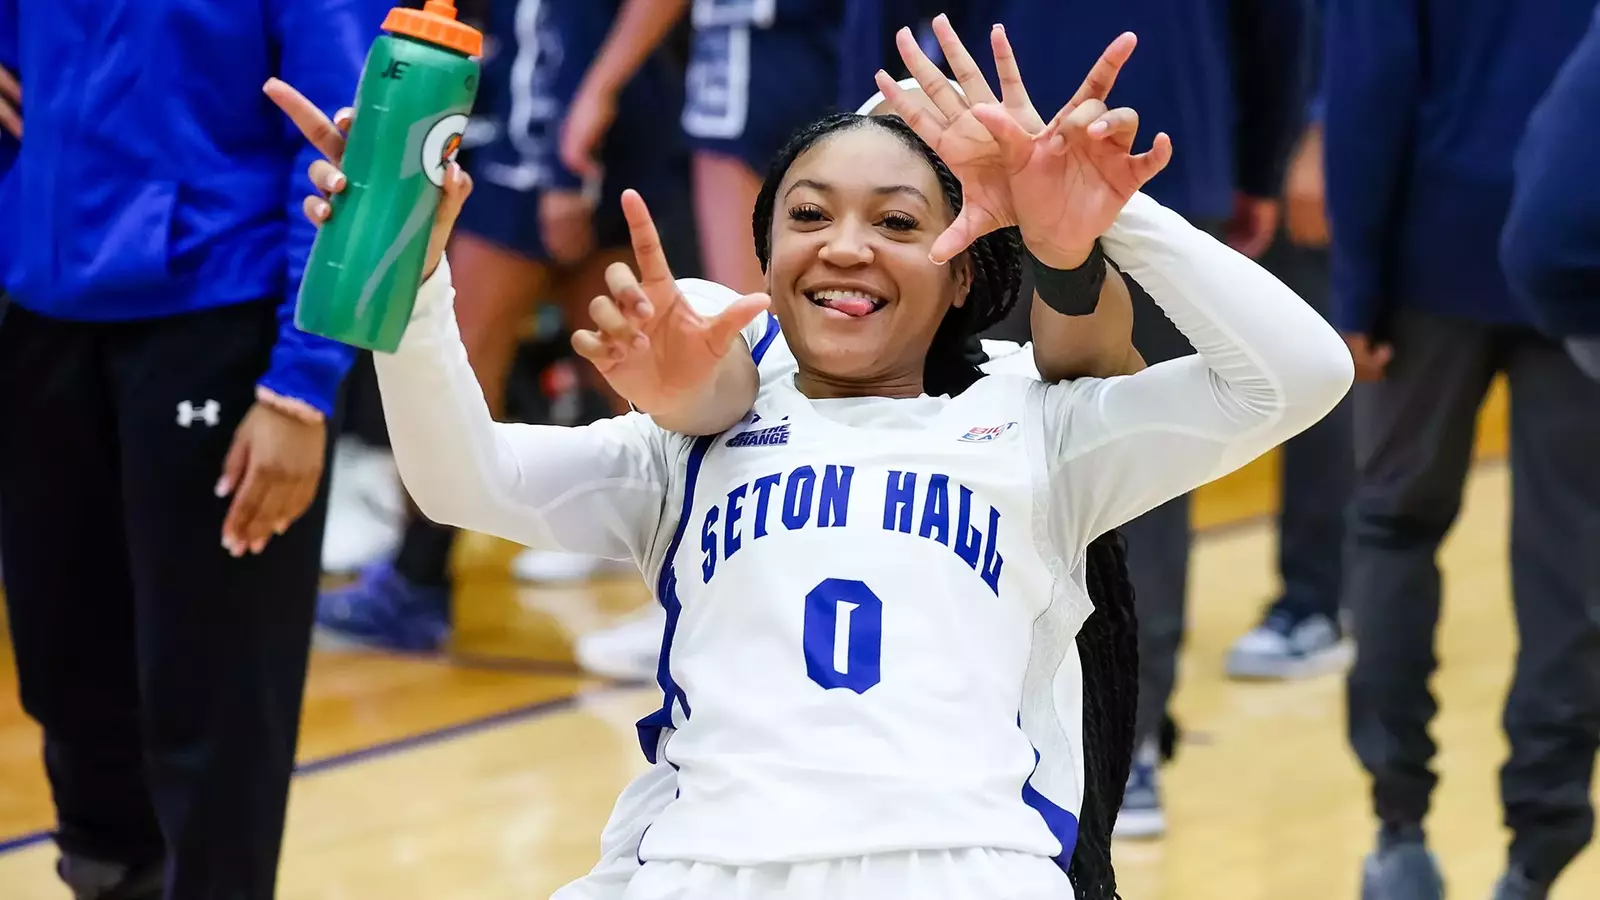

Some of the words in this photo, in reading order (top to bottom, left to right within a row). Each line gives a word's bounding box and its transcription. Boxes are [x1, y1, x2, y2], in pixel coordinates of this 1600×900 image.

[725, 431, 790, 448] CHANGE
[762, 424, 791, 434] THE
[701, 464, 855, 583] SETON
[882, 470, 1004, 597] HALL
[802, 577, 883, 695] 0
